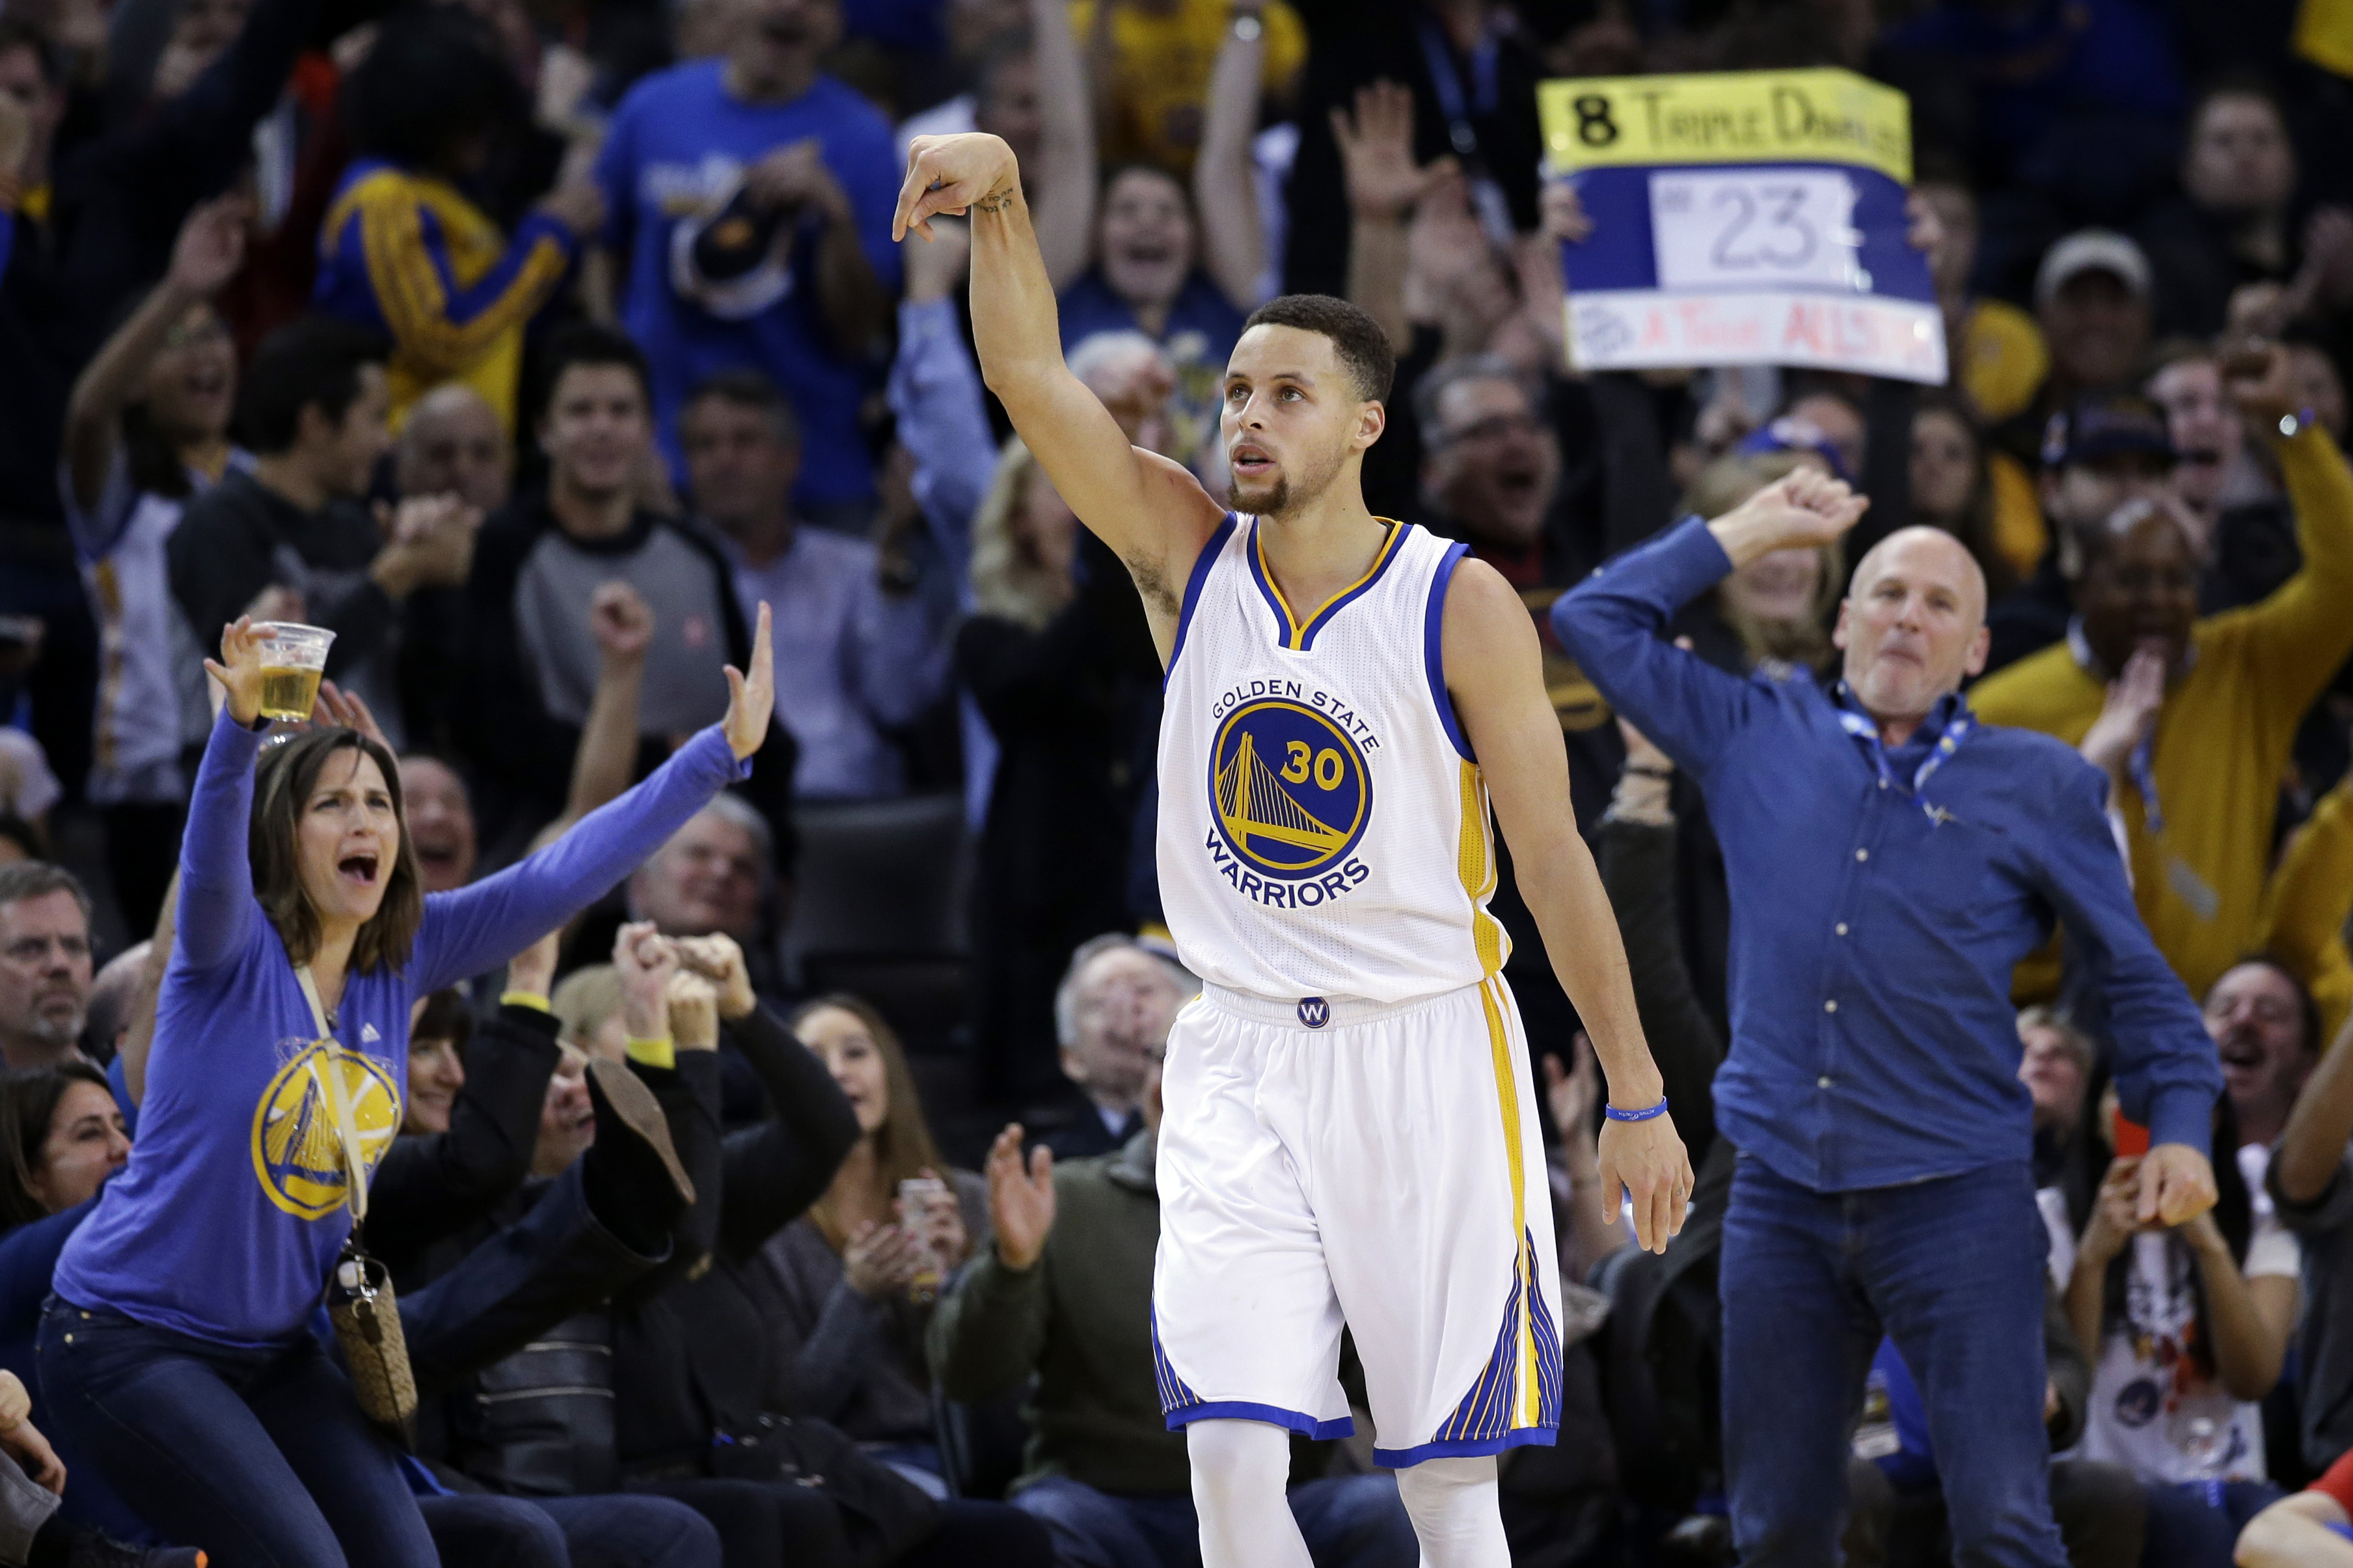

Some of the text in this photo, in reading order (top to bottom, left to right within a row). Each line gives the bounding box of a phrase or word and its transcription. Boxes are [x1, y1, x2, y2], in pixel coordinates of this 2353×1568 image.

[1575, 93, 1618, 149] 8
[1212, 680, 1380, 754] GOLDEN STATE
[1279, 740, 1344, 791] 30
[1204, 826, 1370, 908] WARRIORS
[1300, 1003, 1324, 1022] W
